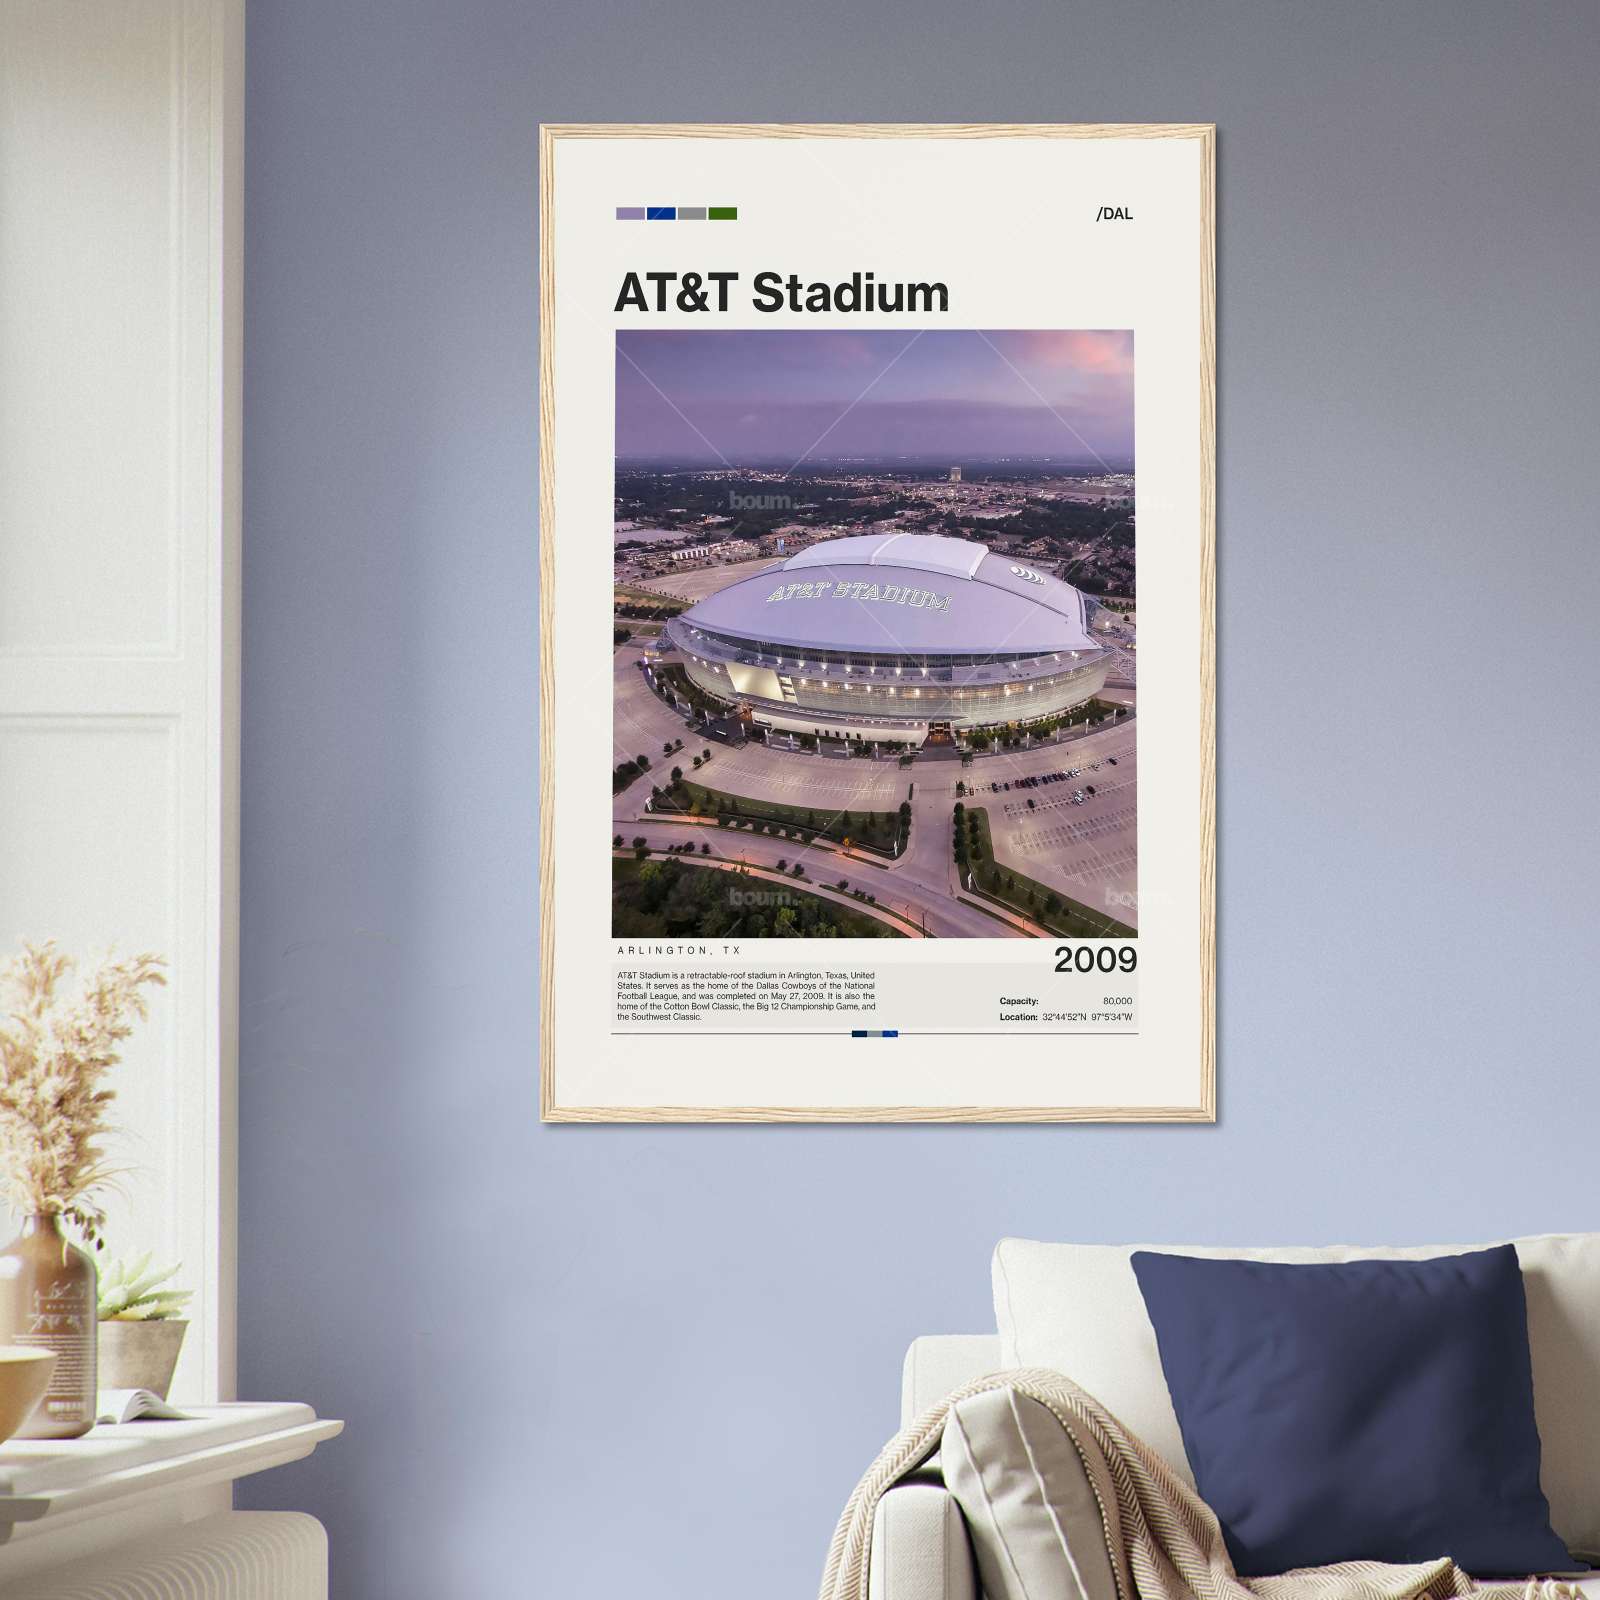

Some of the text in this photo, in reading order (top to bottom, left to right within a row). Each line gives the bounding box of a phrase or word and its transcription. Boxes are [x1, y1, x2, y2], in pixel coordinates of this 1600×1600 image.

[1096, 207, 1133, 222] /DAL
[614, 272, 949, 312] AT&T Stadium
[767, 581, 952, 612] AT&T STADIUM
[617, 946, 740, 956] ARLINGTON, TX
[1054, 946, 1137, 973] 2009
[787, 972, 823, 981] Arlington,
[825, 972, 848, 980] Texas,
[617, 982, 644, 990] States.
[646, 982, 651, 990] It
[692, 982, 705, 990] the
[707, 982, 728, 990] home
[730, 982, 739, 990] of
[741, 982, 754, 990] the
[756, 982, 779, 990] Dallas
[782, 982, 817, 991] Cowboys
[818, 982, 827, 990] of
[829, 982, 842, 990] the
[844, 982, 875, 990] National
[617, 992, 647, 1000] Football
[649, 992, 680, 1001] League,
[681, 992, 696, 1000] and
[716, 992, 756, 1001] completed
[771, 992, 786, 1001] May
[789, 992, 800, 1001] 27,
[802, 992, 825, 1000] 2009.
[827, 992, 833, 1000] It
[835, 992, 842, 1000] is
[844, 992, 860, 1000] also
[863, 992, 875, 1000] the
[1000, 997, 1133, 1006] Capacity: 80,000
[617, 1002, 876, 1012] home of the Cotton Bowl Classic, the Big 12 Championship Game, and
[1000, 1013, 1038, 1021] Location:
